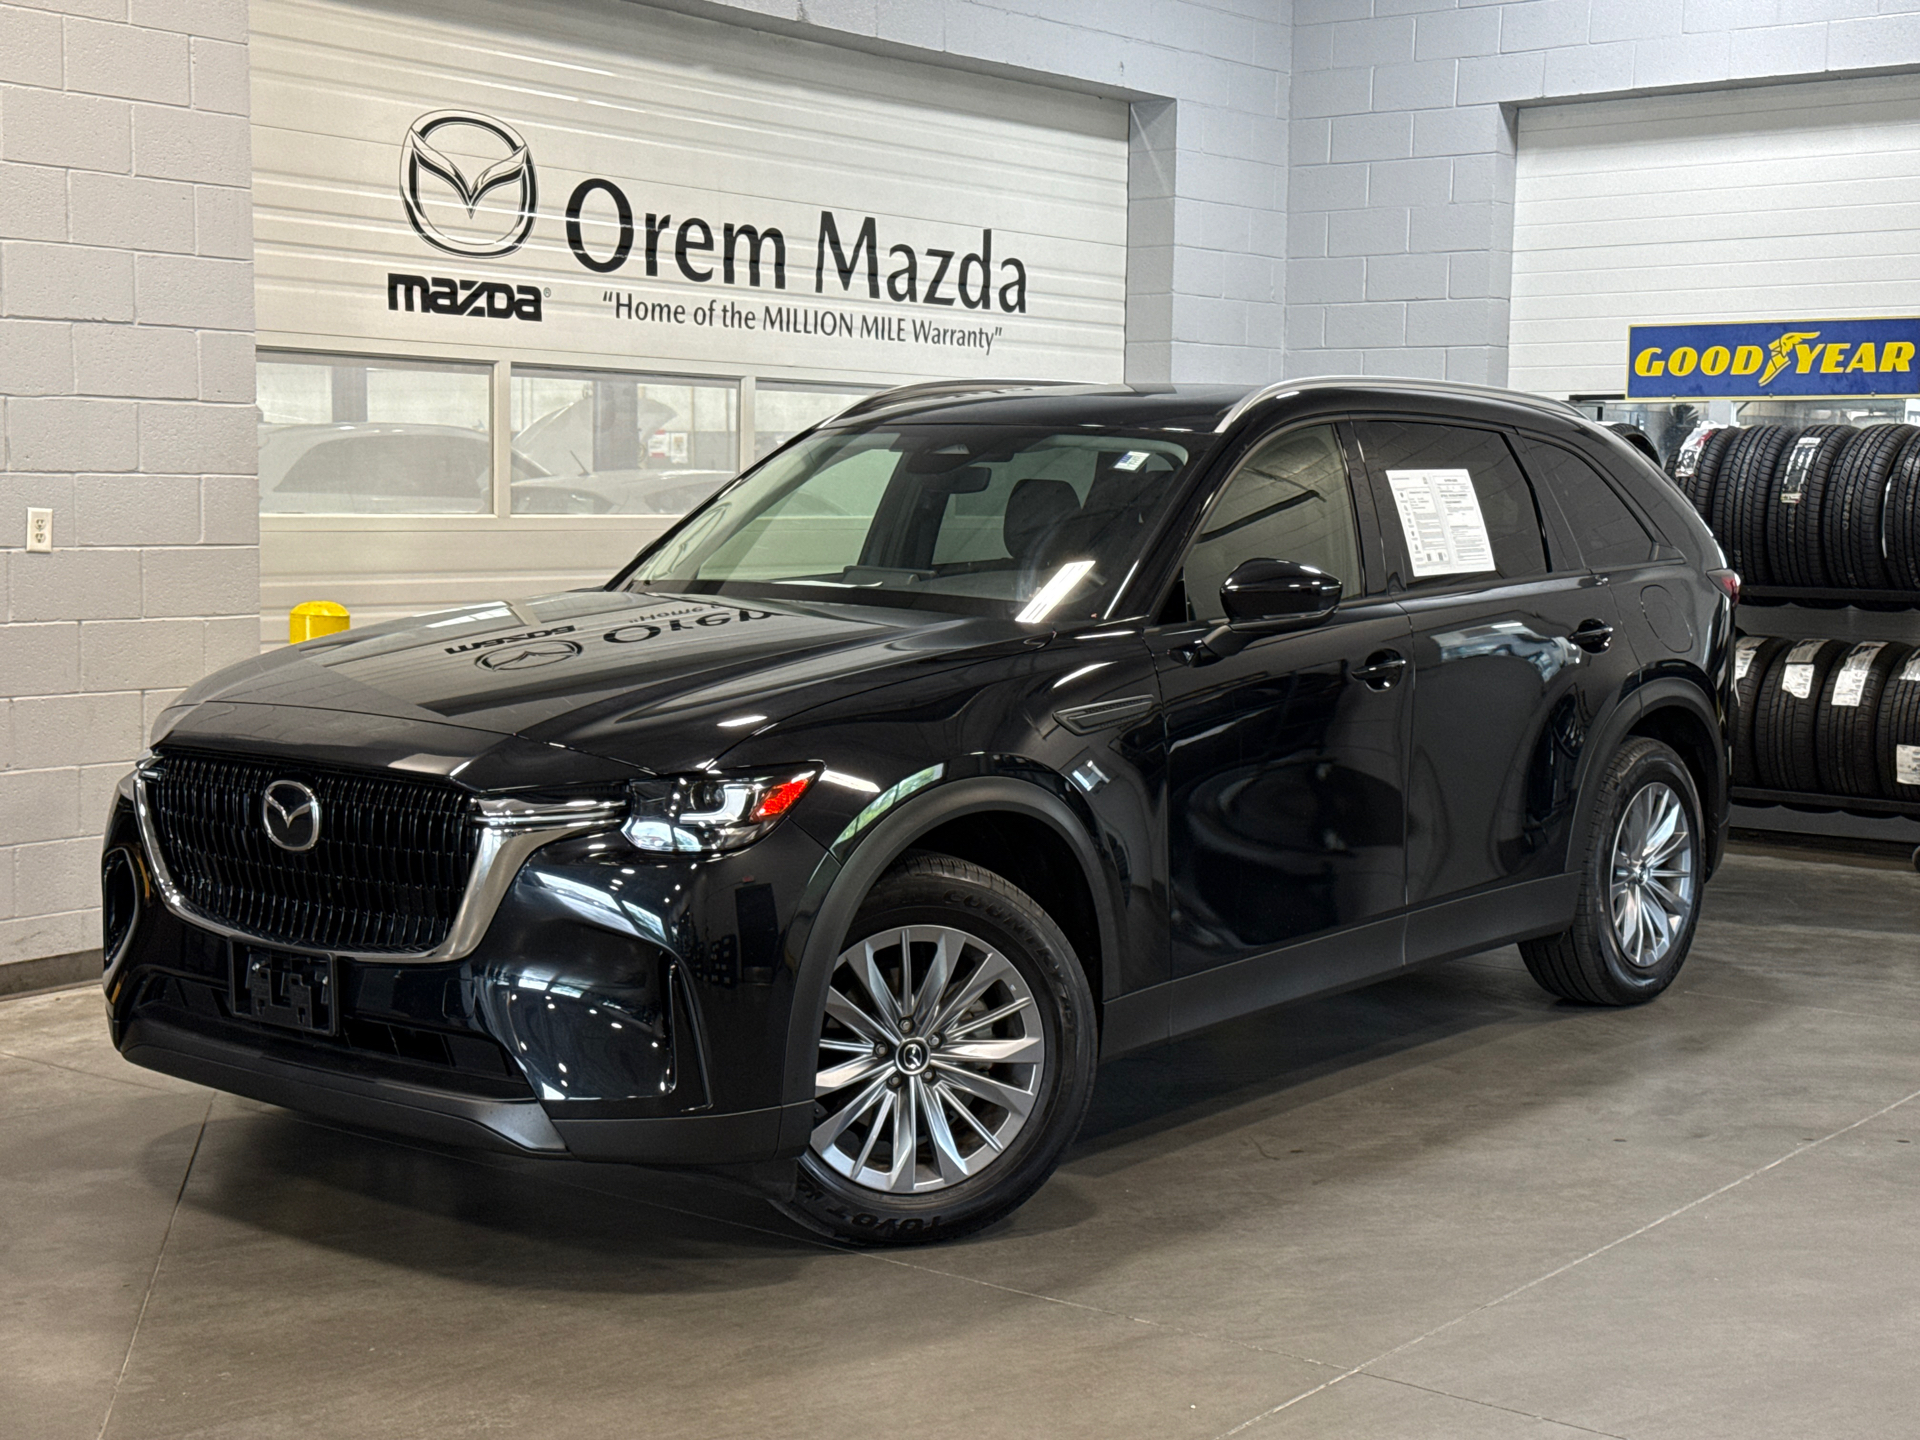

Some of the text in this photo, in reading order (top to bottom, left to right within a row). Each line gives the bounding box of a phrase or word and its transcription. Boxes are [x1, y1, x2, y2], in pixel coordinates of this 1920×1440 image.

[566, 178, 1028, 314] Orem Mazda
[692, 299, 718, 327] of
[722, 301, 757, 330] the
[762, 305, 854, 339] MILLION
[859, 314, 907, 342] MILE
